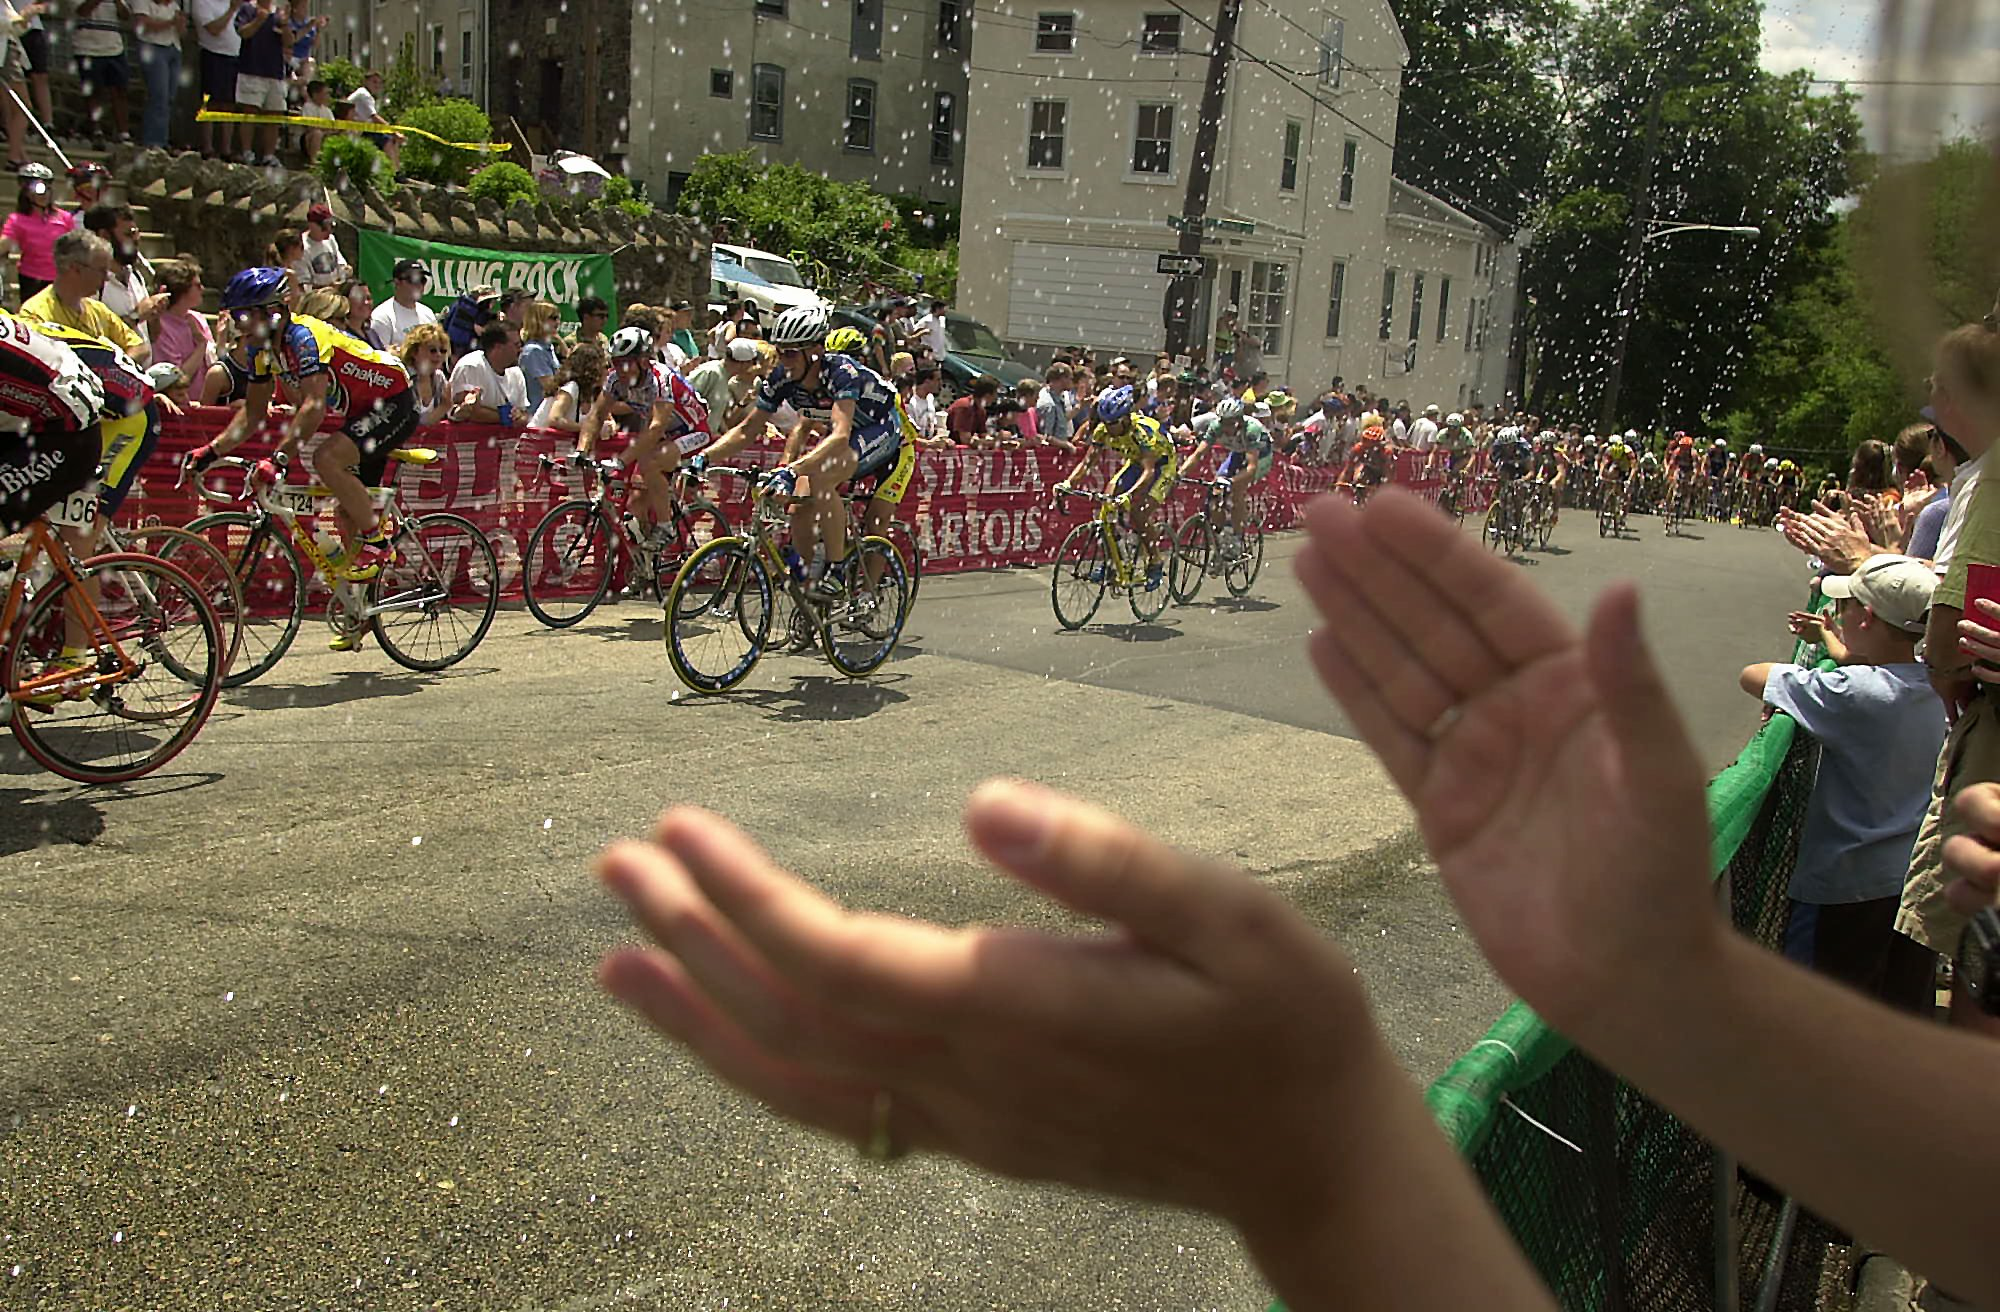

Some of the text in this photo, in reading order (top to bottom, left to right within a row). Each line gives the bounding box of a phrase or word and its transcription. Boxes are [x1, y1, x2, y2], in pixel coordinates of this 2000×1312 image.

[508, 259, 583, 305] ROCK
[917, 448, 1043, 497] STELLA
[61, 497, 96, 522] 136
[289, 494, 313, 513] 124
[918, 505, 1043, 560] ARTOIS
